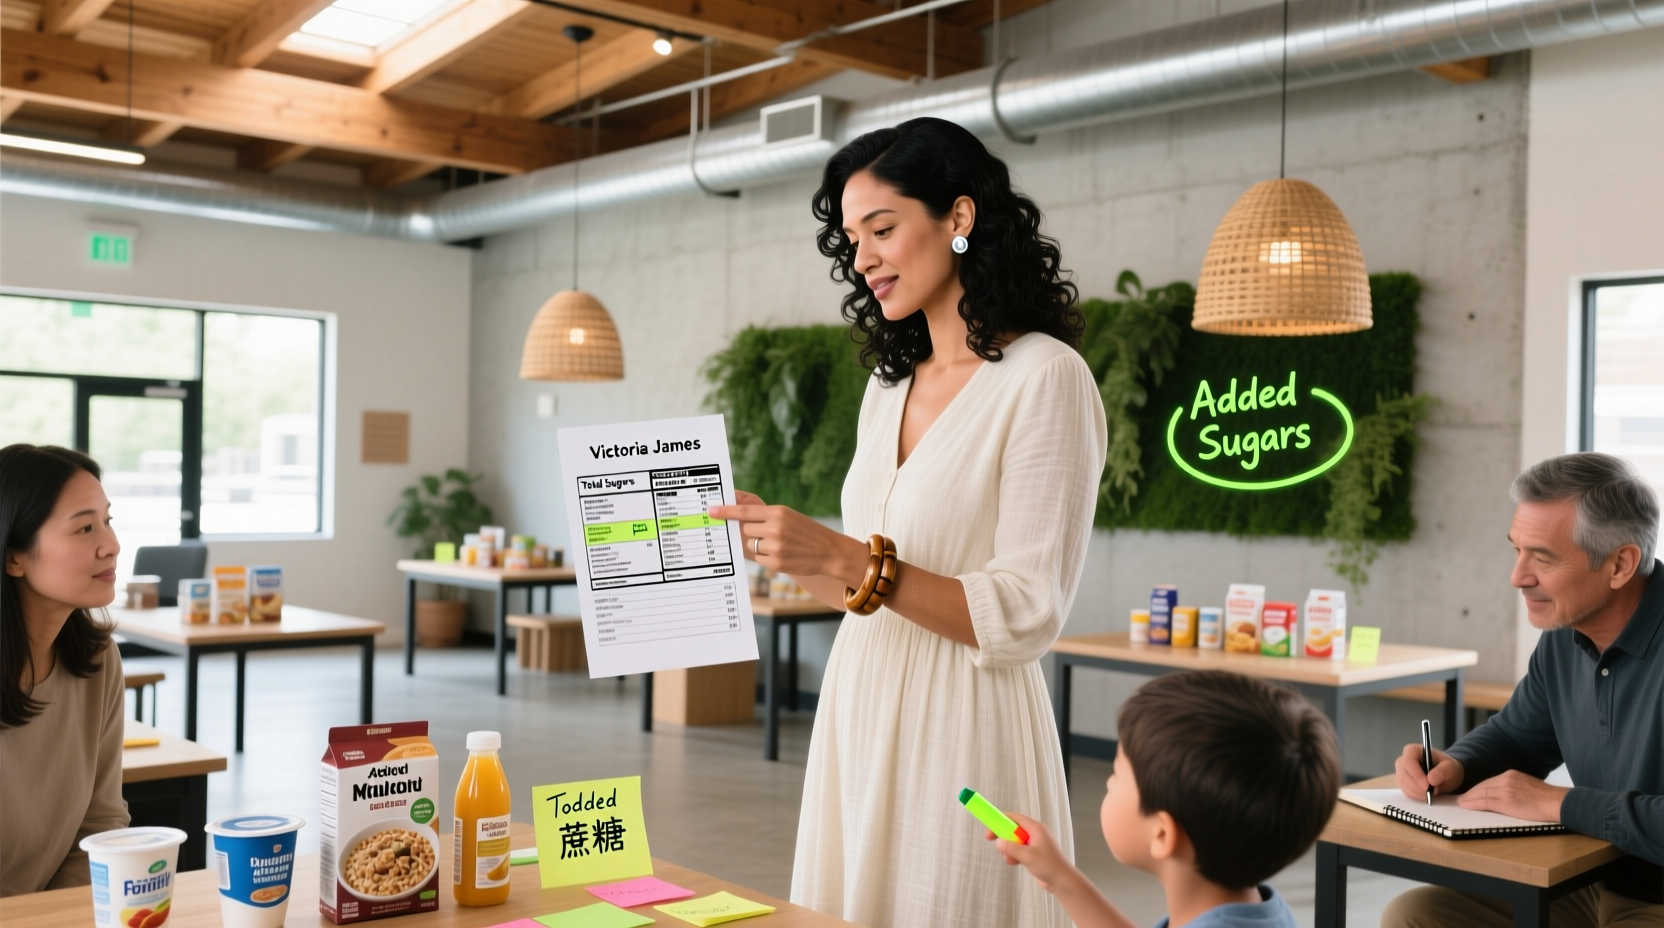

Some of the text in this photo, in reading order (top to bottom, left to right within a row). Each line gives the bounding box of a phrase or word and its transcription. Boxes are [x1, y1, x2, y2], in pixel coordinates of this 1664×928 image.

[1190, 371, 1297, 420] Added
[589, 438, 702, 460] Victoria James
[1198, 423, 1311, 470] Sugars
[546, 788, 617, 818] Todded
[559, 816, 627, 860] 蔗糖
